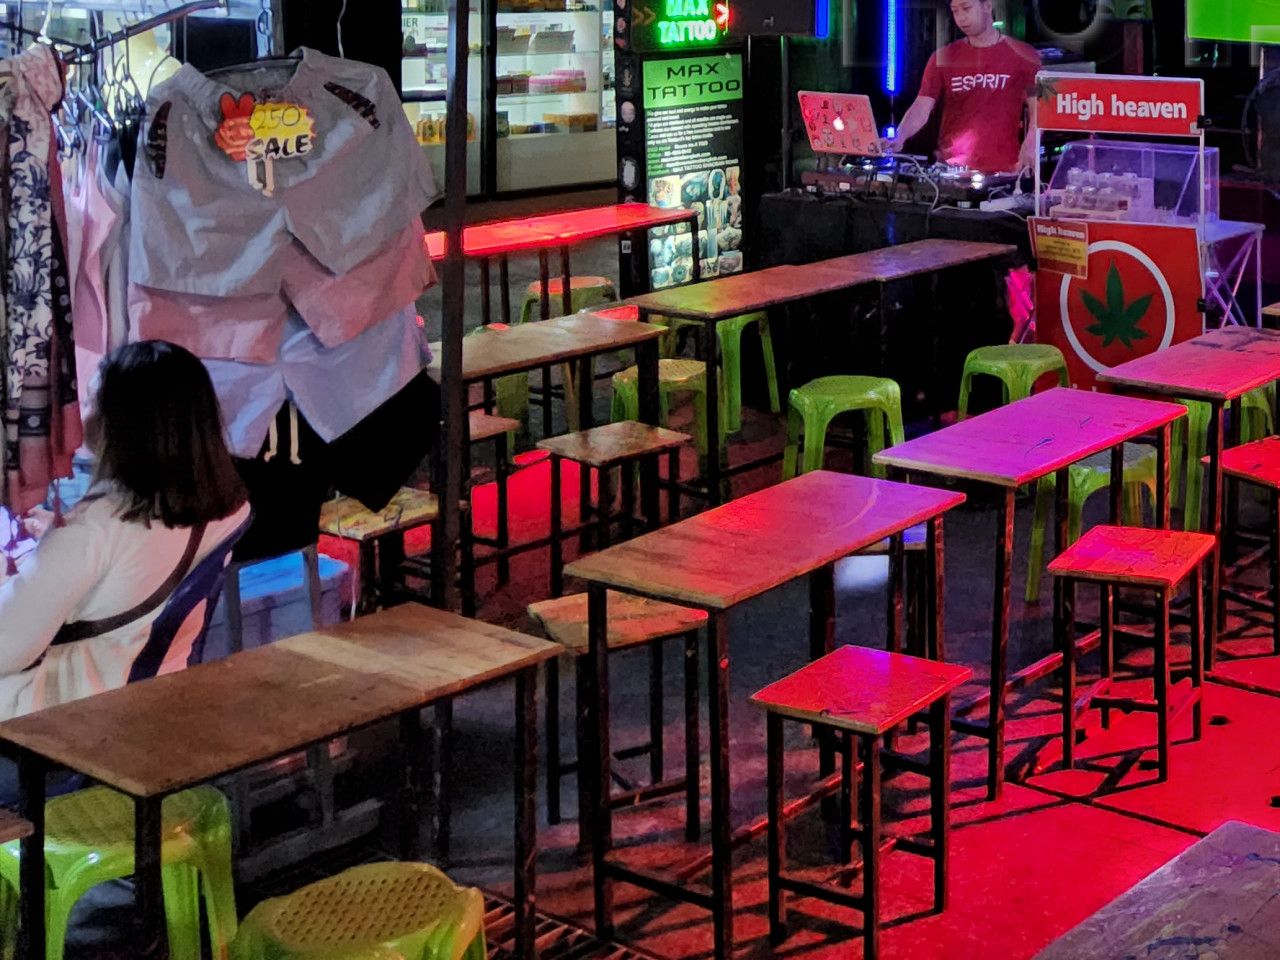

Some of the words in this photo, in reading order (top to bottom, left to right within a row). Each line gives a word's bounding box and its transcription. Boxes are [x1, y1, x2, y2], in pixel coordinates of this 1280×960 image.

[658, 19, 717, 43] TATTOO
[667, 62, 719, 79] MAX
[951, 73, 1011, 92] ESPRIT
[647, 79, 740, 101] TATTOO
[254, 106, 301, 130] 250
[1056, 92, 1104, 121] High
[1111, 94, 1187, 119] heaven
[247, 134, 309, 160] SALE
